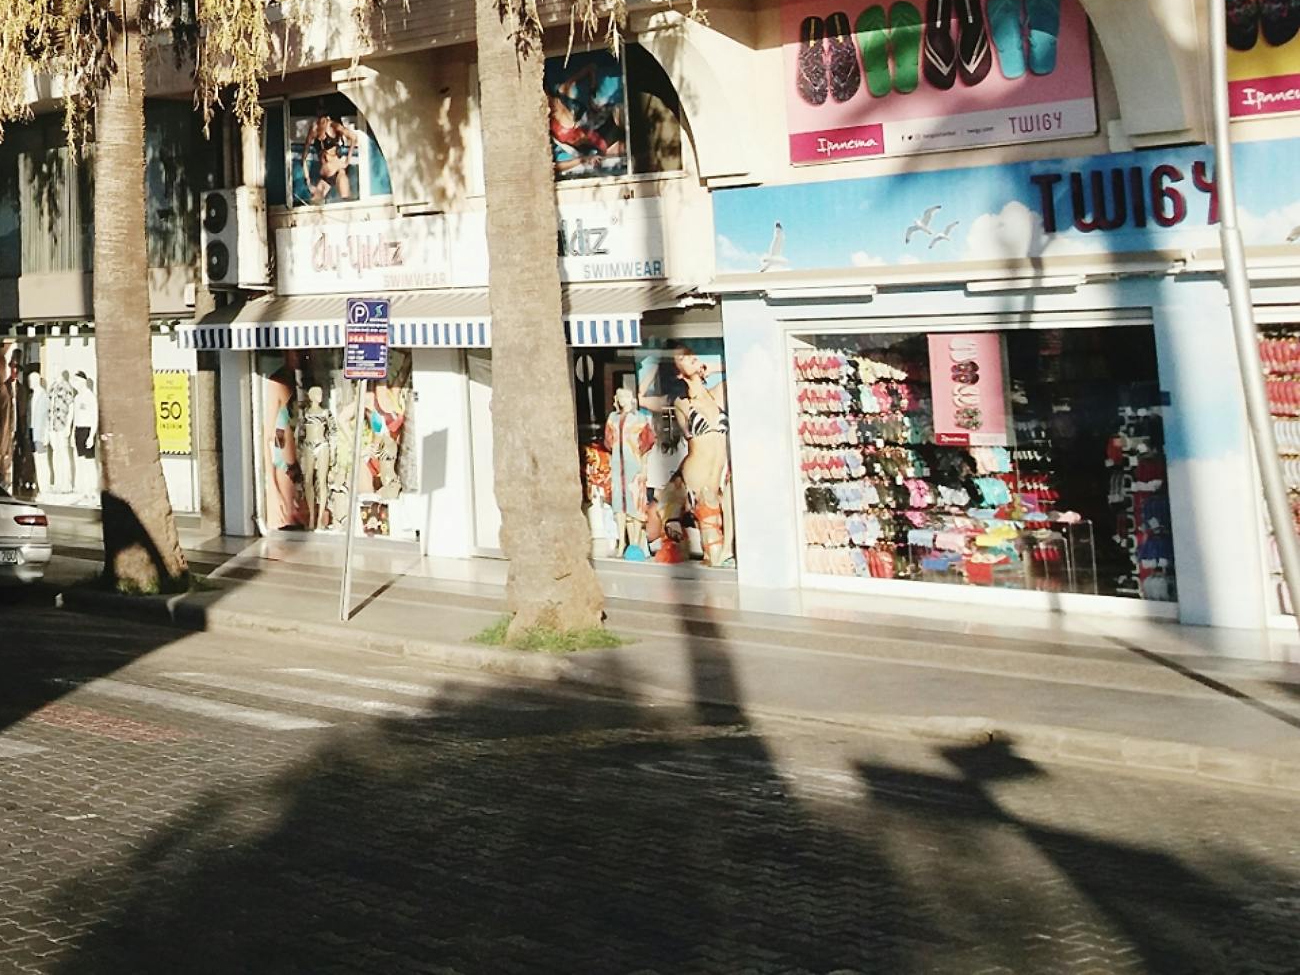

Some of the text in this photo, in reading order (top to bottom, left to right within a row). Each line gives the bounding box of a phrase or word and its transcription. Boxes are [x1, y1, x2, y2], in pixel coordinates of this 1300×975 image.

[816, 137, 878, 156] Ipanema
[583, 260, 663, 279] SWIMWEAR
[383, 272, 447, 288] SWIMWEAR
[355, 306, 365, 322] P
[160, 401, 182, 420] 50
